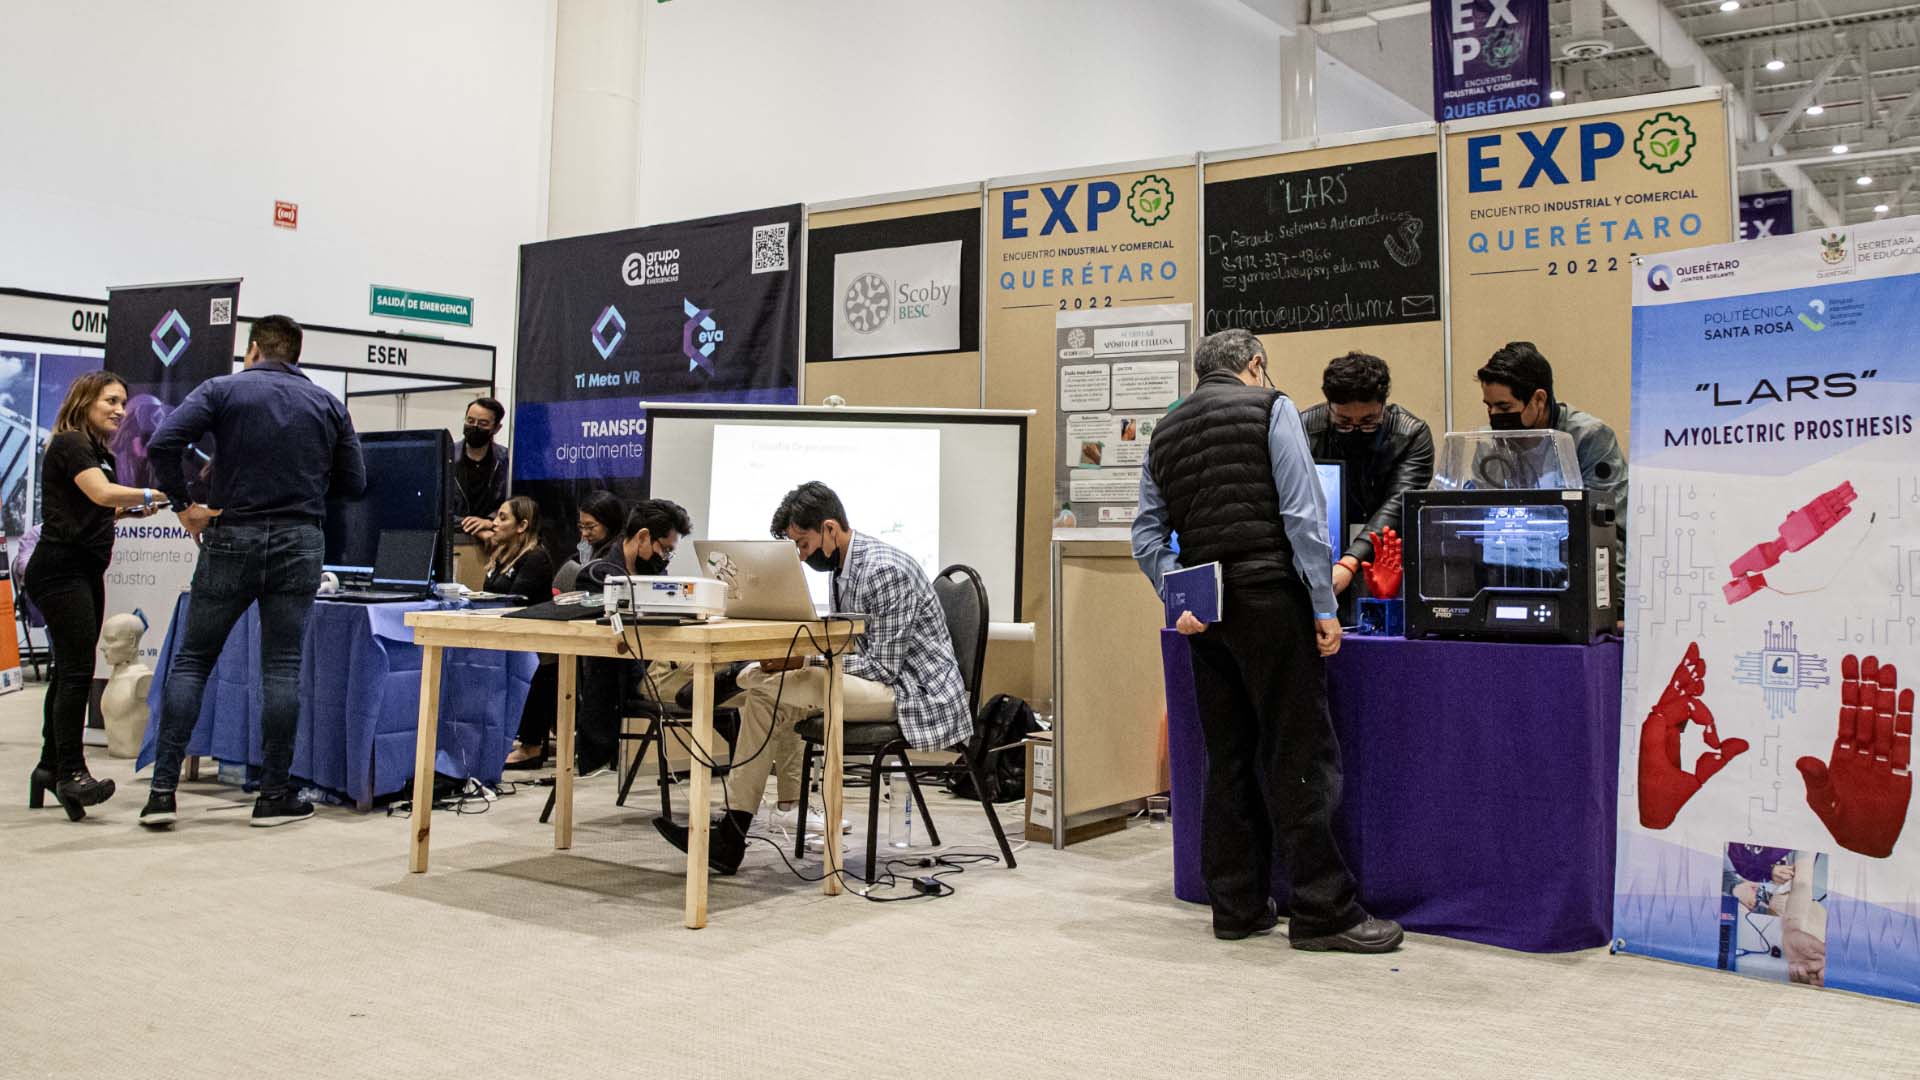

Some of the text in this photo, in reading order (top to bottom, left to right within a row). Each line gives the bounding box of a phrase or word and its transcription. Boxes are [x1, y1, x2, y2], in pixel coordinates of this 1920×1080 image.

[1464, 74, 1512, 87] ENCUENTRO
[1486, 85, 1493, 93] Y
[1493, 78, 1539, 91] COMERCIAL
[1444, 93, 1540, 120] QUERÉTARO
[1470, 189, 1698, 219] ENCUENTRO INDUSTRIAL Y COMERCIAL
[1280, 219, 1327, 239] Sistemas
[1468, 213, 1701, 253] QUERÉTARO
[646, 249, 680, 266] grupo
[1003, 240, 1175, 262] ENCUENTRO INDUSTRIAL Y COMERCIAL
[1858, 252, 1871, 262] DE
[1000, 260, 1177, 290] QUERÉTARO
[1548, 257, 1618, 276] 2022
[1676, 259, 1740, 276] QUERÉTARO
[898, 280, 951, 306] Scoby
[1059, 296, 1113, 310] 2022
[377, 295, 468, 315] SALIDA DE EMERGENCIA
[899, 303, 930, 320] BESC
[699, 329, 724, 343] eva
[1704, 321, 1794, 341] SANTA ROSA
[368, 344, 407, 366] ESEN
[575, 370, 641, 389] Ti Meta VR
[1664, 414, 1913, 448] MYOLECTRIC PROSTHESIS
[556, 441, 643, 464] digitalmente
